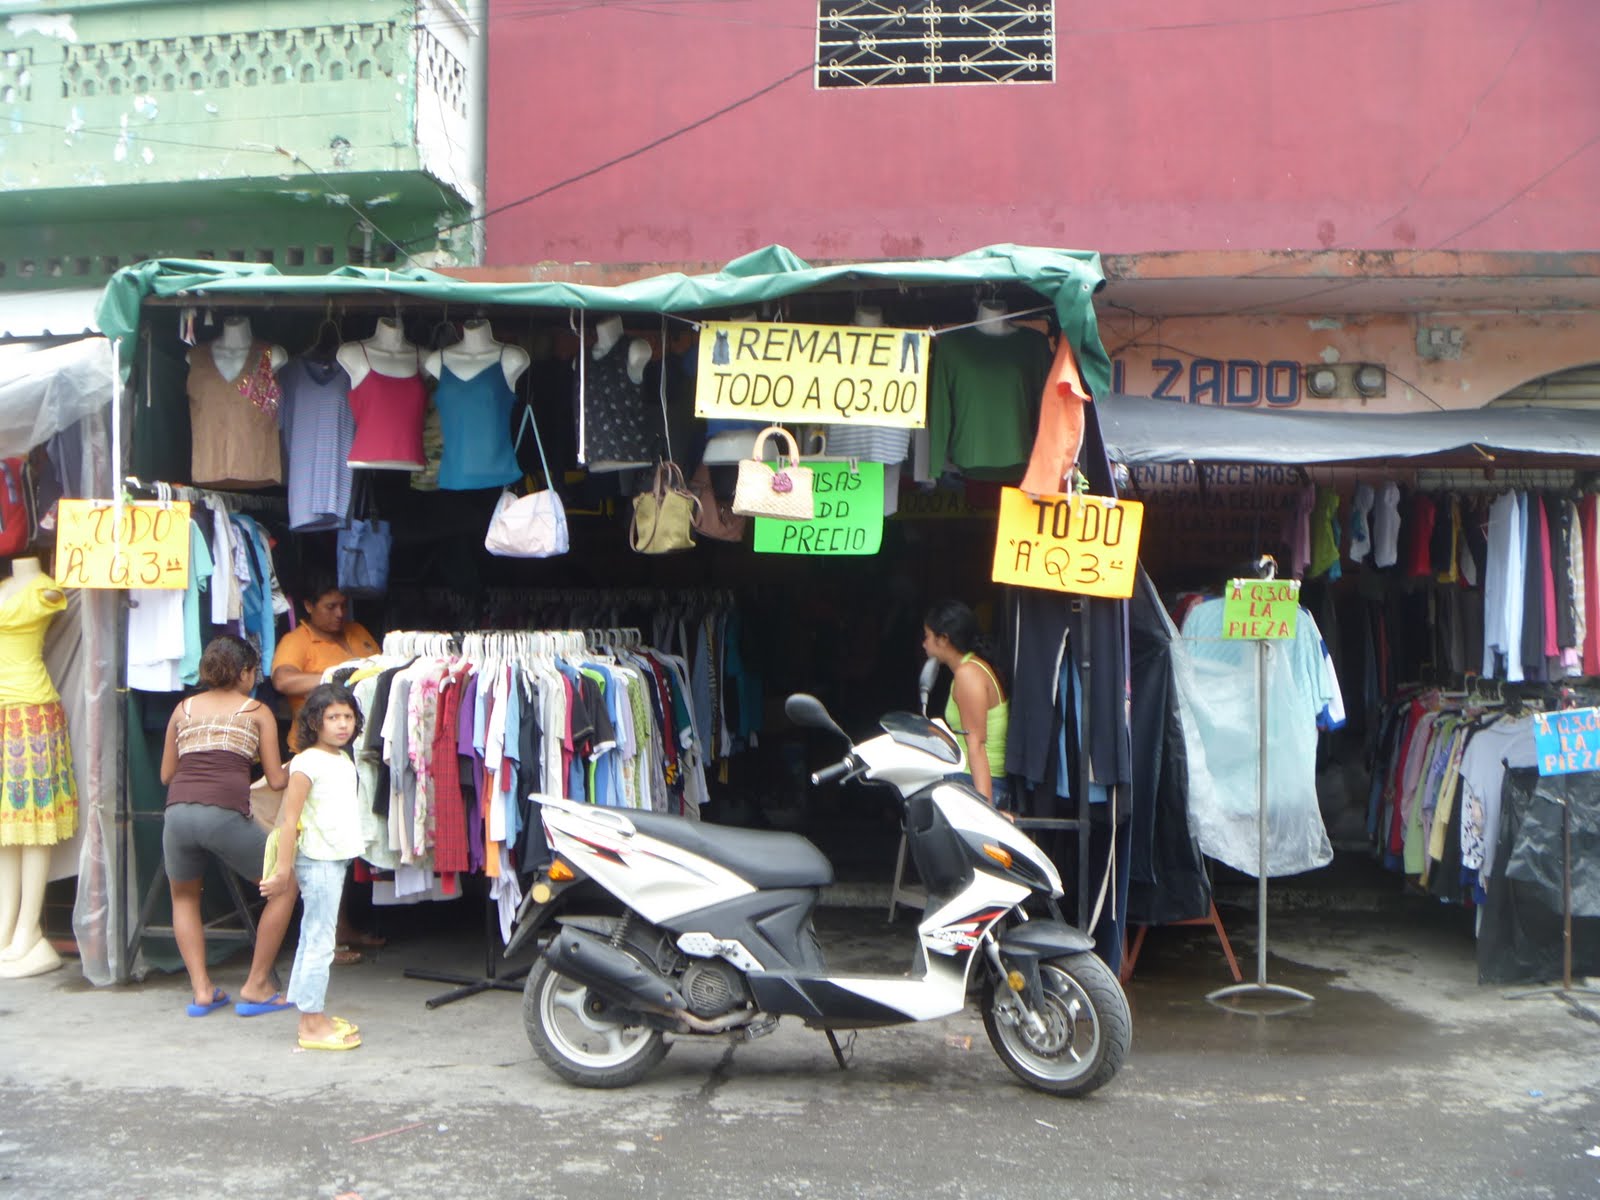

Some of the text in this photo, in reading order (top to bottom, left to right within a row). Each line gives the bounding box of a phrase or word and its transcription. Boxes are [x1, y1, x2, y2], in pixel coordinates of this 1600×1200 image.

[736, 327, 895, 367] REMATE
[713, 372, 917, 418] TODO A Q3.00
[811, 471, 862, 493] ISAS
[1183, 462, 1298, 486] ORECEMOS
[1032, 499, 1124, 546] TODO
[781, 524, 866, 552] PRECIO
[1232, 586, 1242, 601] A
[1249, 602, 1272, 618] LA
[1229, 621, 1289, 637] PIEZA
[1541, 719, 1552, 736] A
[1561, 735, 1587, 751] LA
